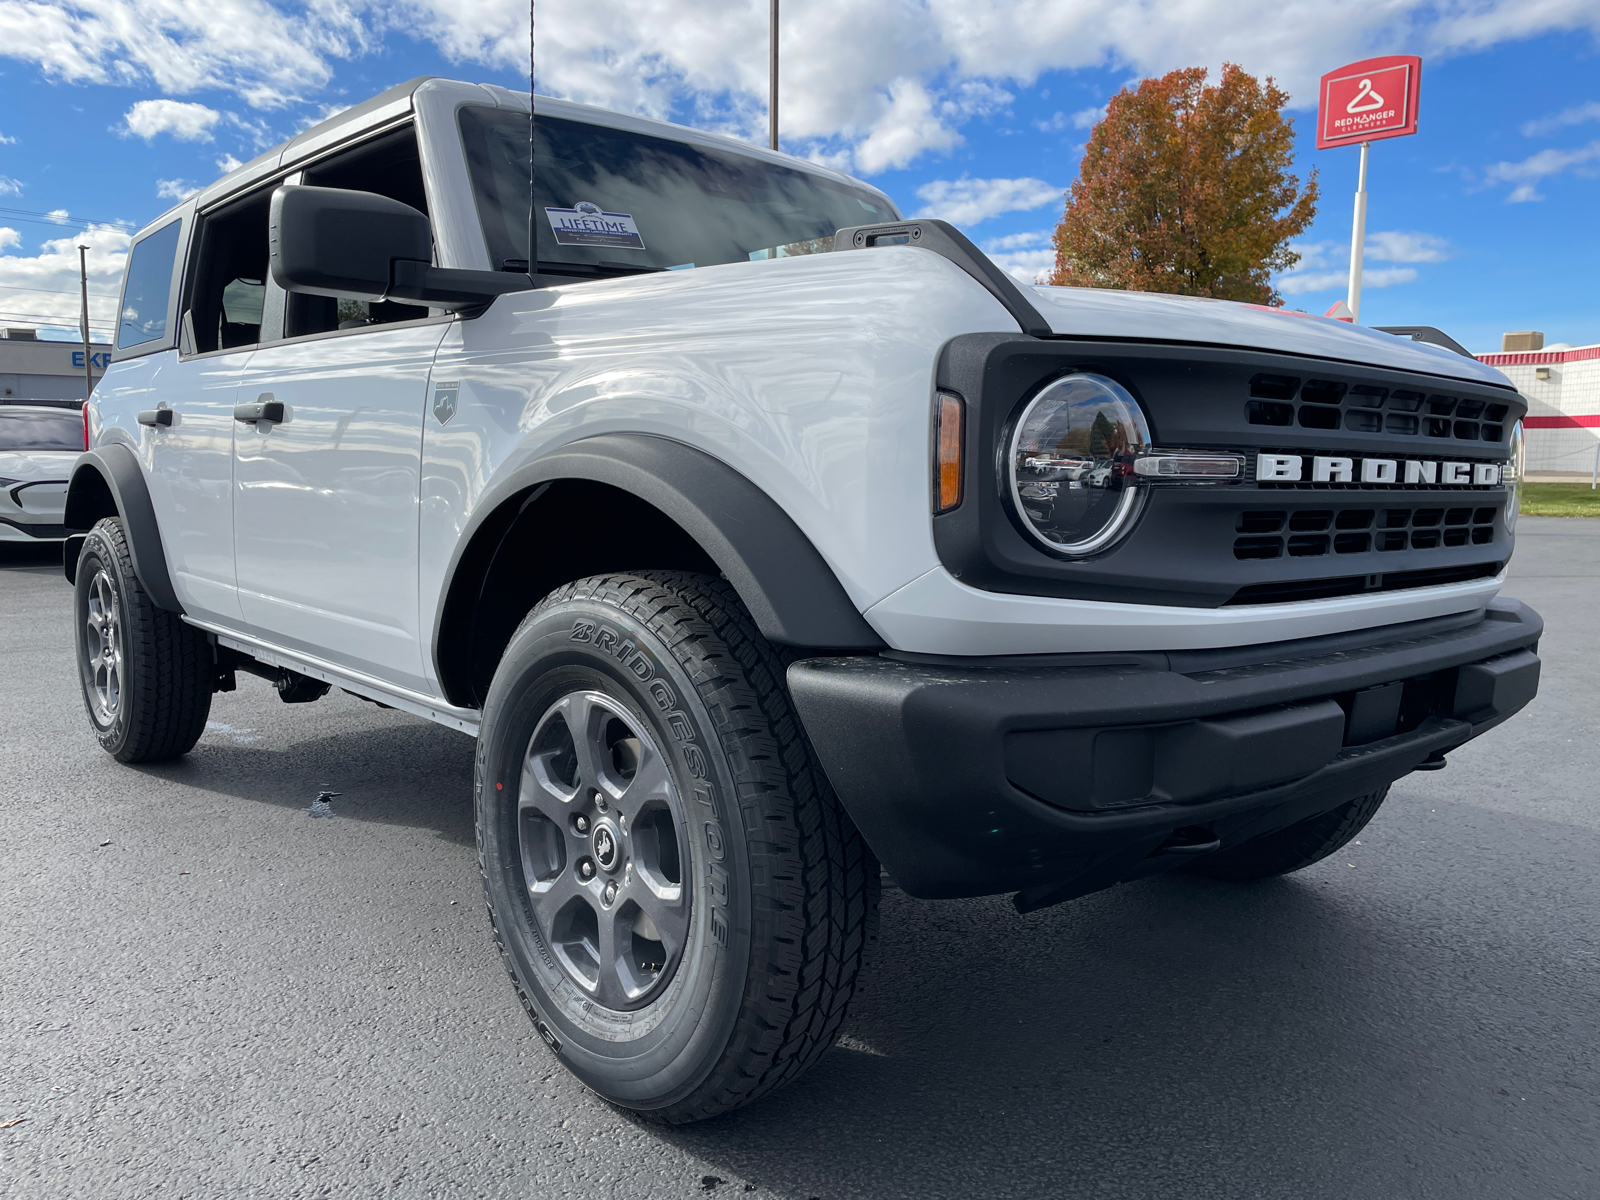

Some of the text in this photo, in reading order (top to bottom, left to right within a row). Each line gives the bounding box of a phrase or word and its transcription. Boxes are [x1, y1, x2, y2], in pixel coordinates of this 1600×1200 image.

[1334, 118, 1353, 128] RED
[1341, 119, 1387, 132] CLEANERS
[560, 218, 629, 232] LIFETIME
[1257, 453, 1498, 485] BRONCO
[568, 617, 731, 949] BRIDGESTONE
